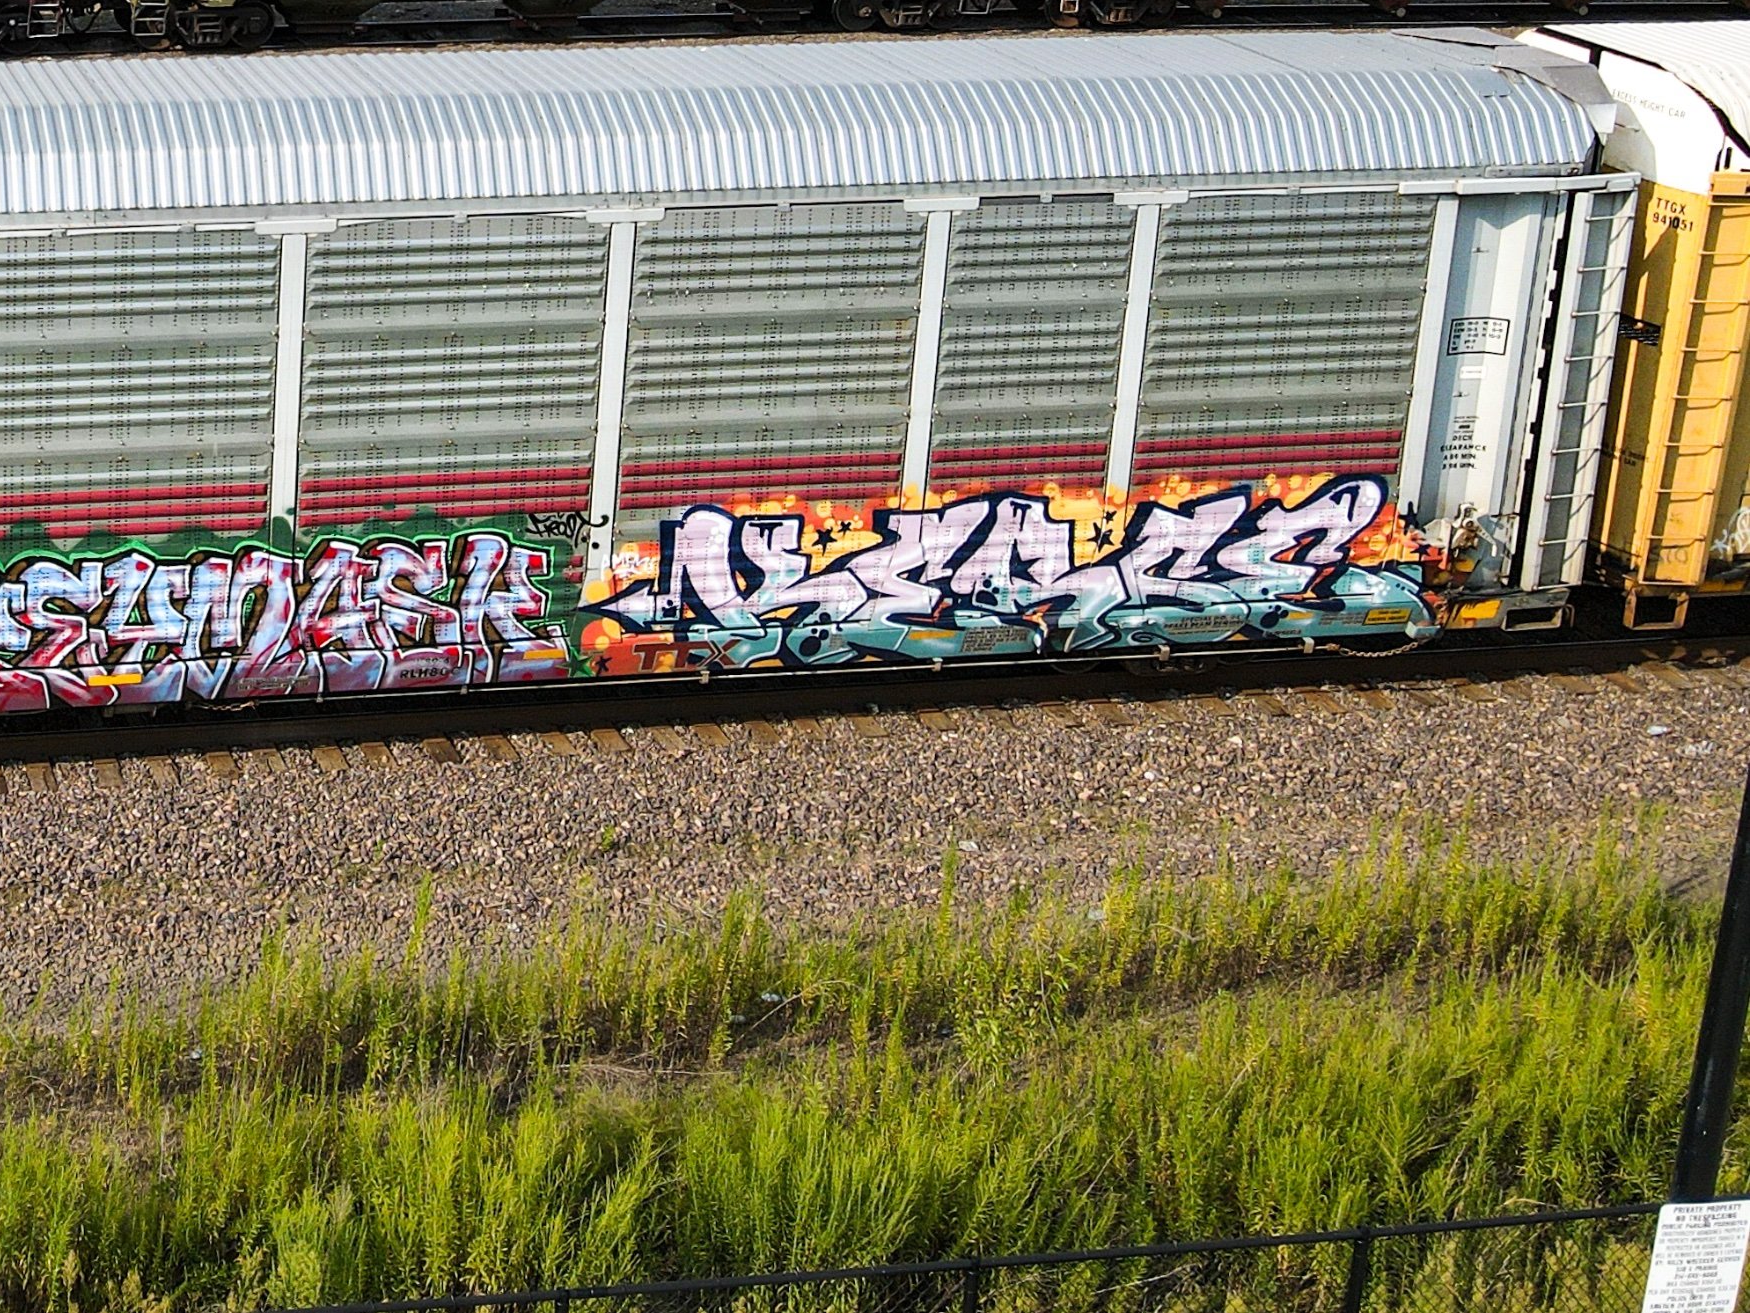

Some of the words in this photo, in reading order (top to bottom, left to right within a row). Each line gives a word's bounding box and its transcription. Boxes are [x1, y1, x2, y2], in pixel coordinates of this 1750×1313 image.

[1655, 197, 1687, 215] TTGX
[1652, 211, 1694, 233] 941051
[633, 639, 743, 672] TTX
